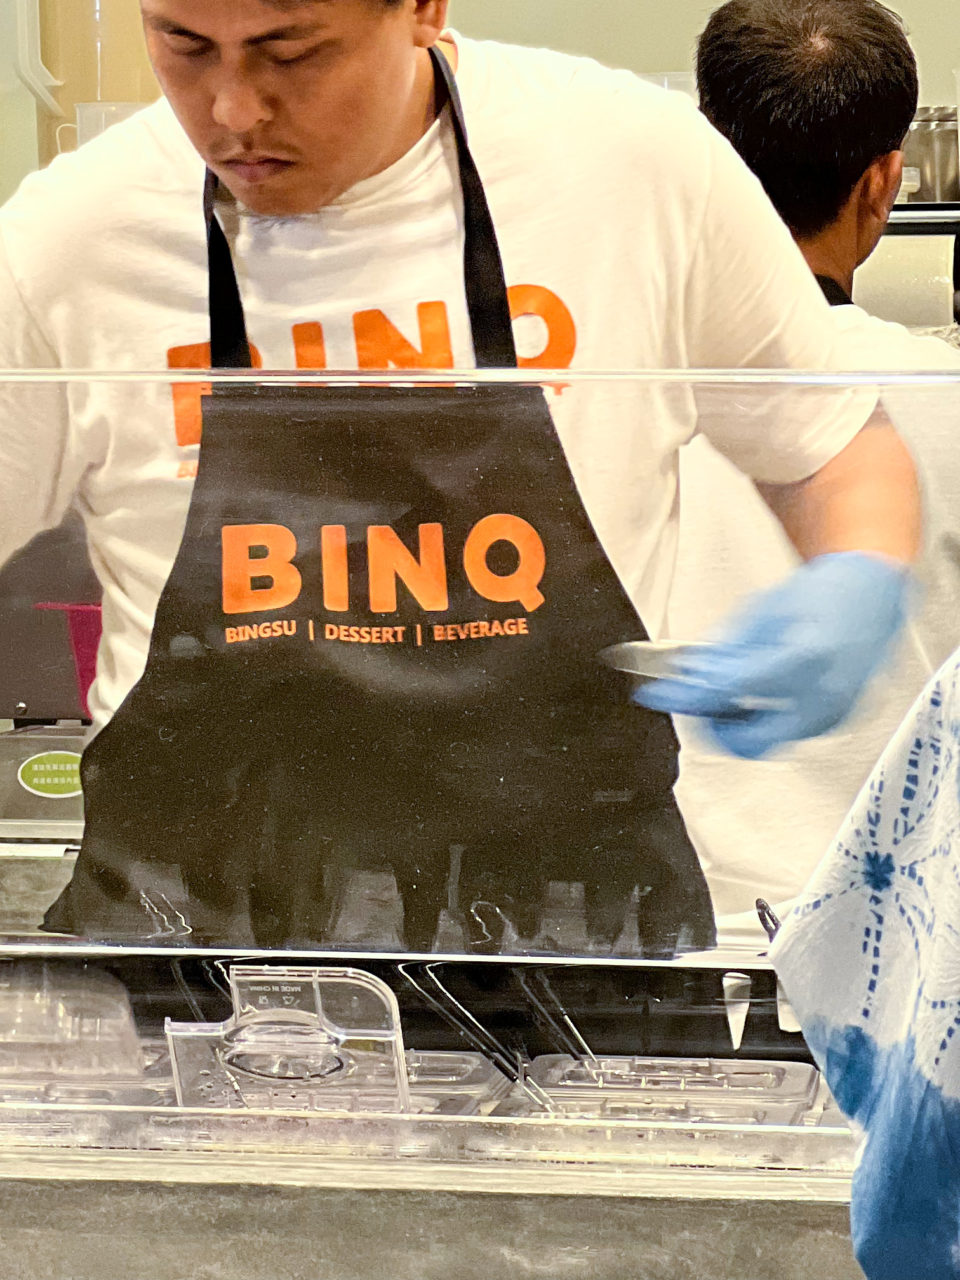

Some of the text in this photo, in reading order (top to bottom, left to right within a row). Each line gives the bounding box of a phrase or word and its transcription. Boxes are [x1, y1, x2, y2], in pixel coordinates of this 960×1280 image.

[221, 513, 547, 614] BINQ
[224, 617, 529, 644] BINGSU DESSERT BEVERAGE
